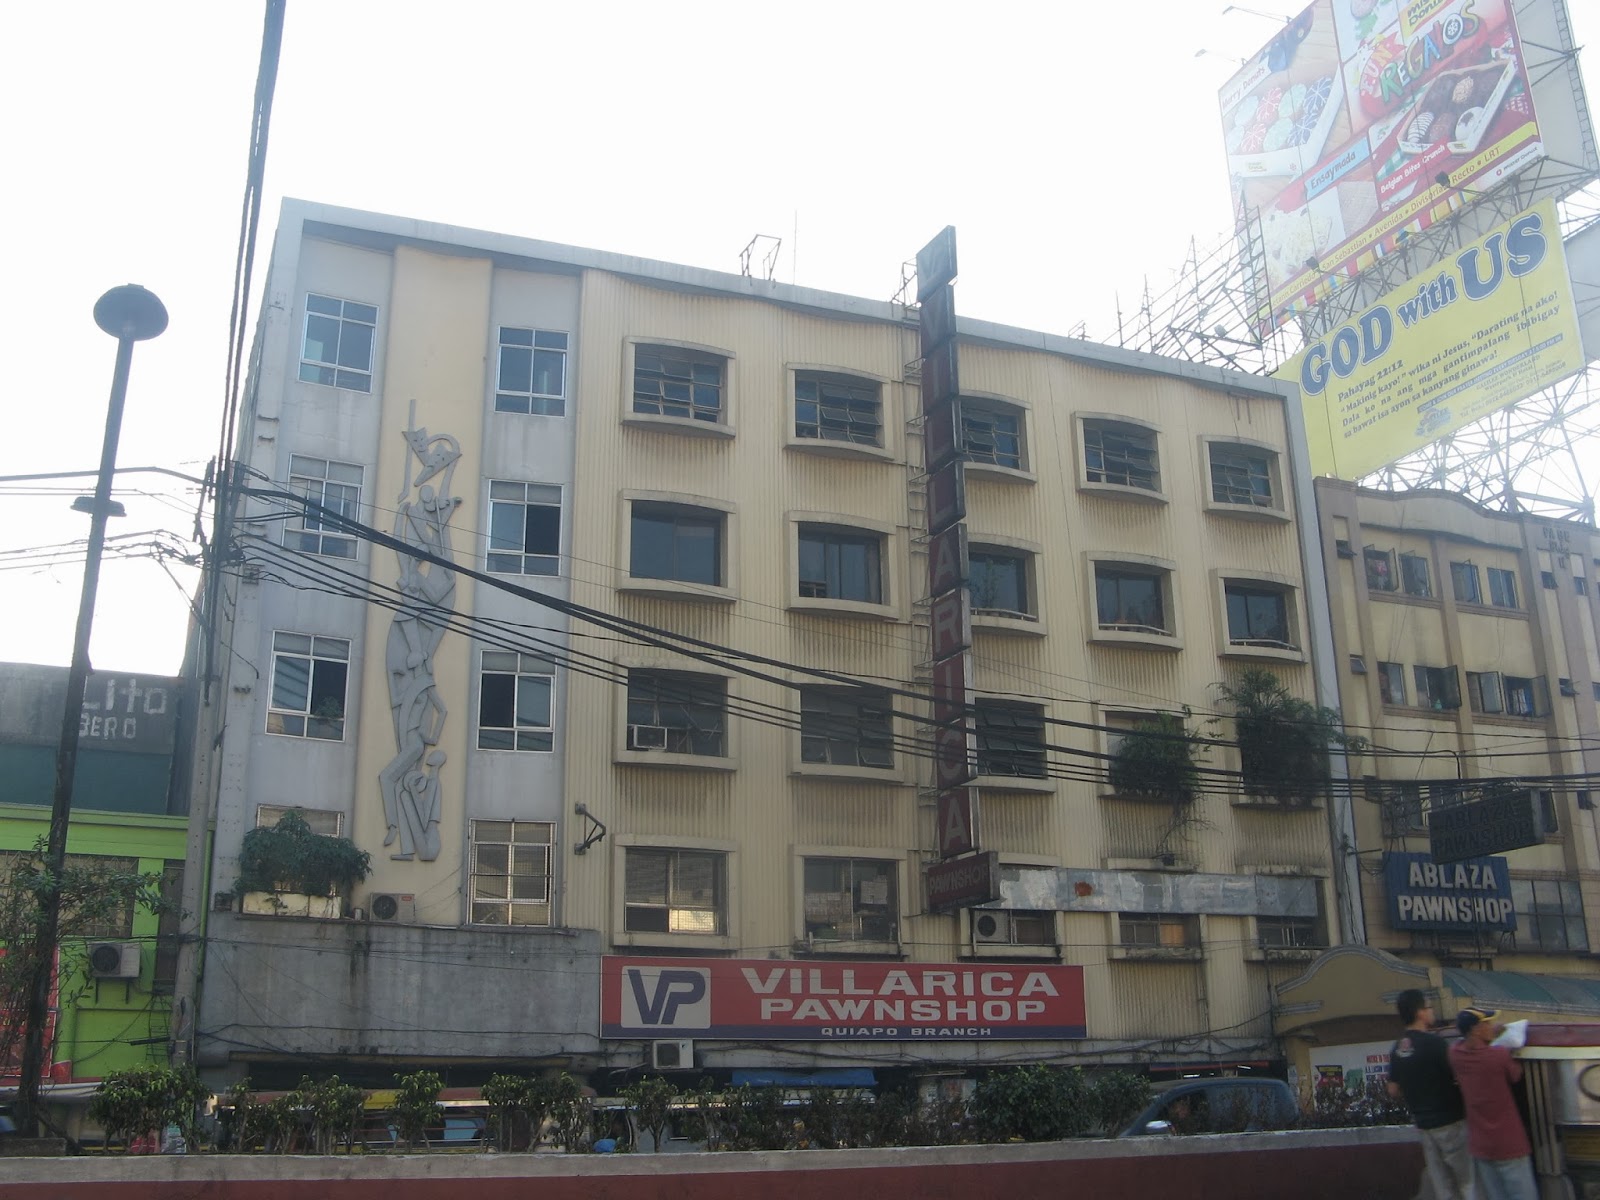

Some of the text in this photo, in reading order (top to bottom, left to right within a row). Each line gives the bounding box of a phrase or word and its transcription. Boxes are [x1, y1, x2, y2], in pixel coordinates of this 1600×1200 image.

[1380, 0, 1480, 103] REGALOS
[1243, 67, 1265, 90] Donuts
[1311, 151, 1356, 189] Ensaymada
[1380, 144, 1446, 194] Belgian Bites Crunch
[1451, 164, 1476, 184] Recto
[1483, 146, 1502, 162] LRT
[1301, 304, 1394, 396] GOD
[1396, 271, 1458, 329] with
[1457, 212, 1547, 301] US
[1407, 361, 1431, 378] wika
[1432, 353, 1442, 364] ni
[1442, 340, 1470, 359] Jesus,
[1520, 305, 1533, 317] na
[1535, 290, 1558, 310] ako!
[1337, 360, 1404, 403] Pahayag 22:12
[1342, 413, 1360, 428] Dala
[1365, 403, 1376, 416] ko
[1381, 395, 1392, 406] na
[1397, 384, 1414, 397] ang
[1418, 370, 1438, 386] mga
[1443, 330, 1510, 373] gantimpalang
[1353, 413, 1376, 433] bawat
[1378, 409, 1389, 421] isa
[1390, 398, 1411, 416] ayon
[1411, 391, 1421, 402] sa
[1422, 372, 1461, 397] kanyang
[1461, 350, 1498, 377] ginawa!
[1409, 862, 1497, 890] ABLAZA
[1397, 895, 1513, 924] PAWNSHOP
[628, 969, 706, 1025] VP
[741, 967, 1059, 996] VILLARICA
[761, 999, 1046, 1022] PAWNSHOP
[821, 1027, 992, 1037] QUIAPO BRANCH
